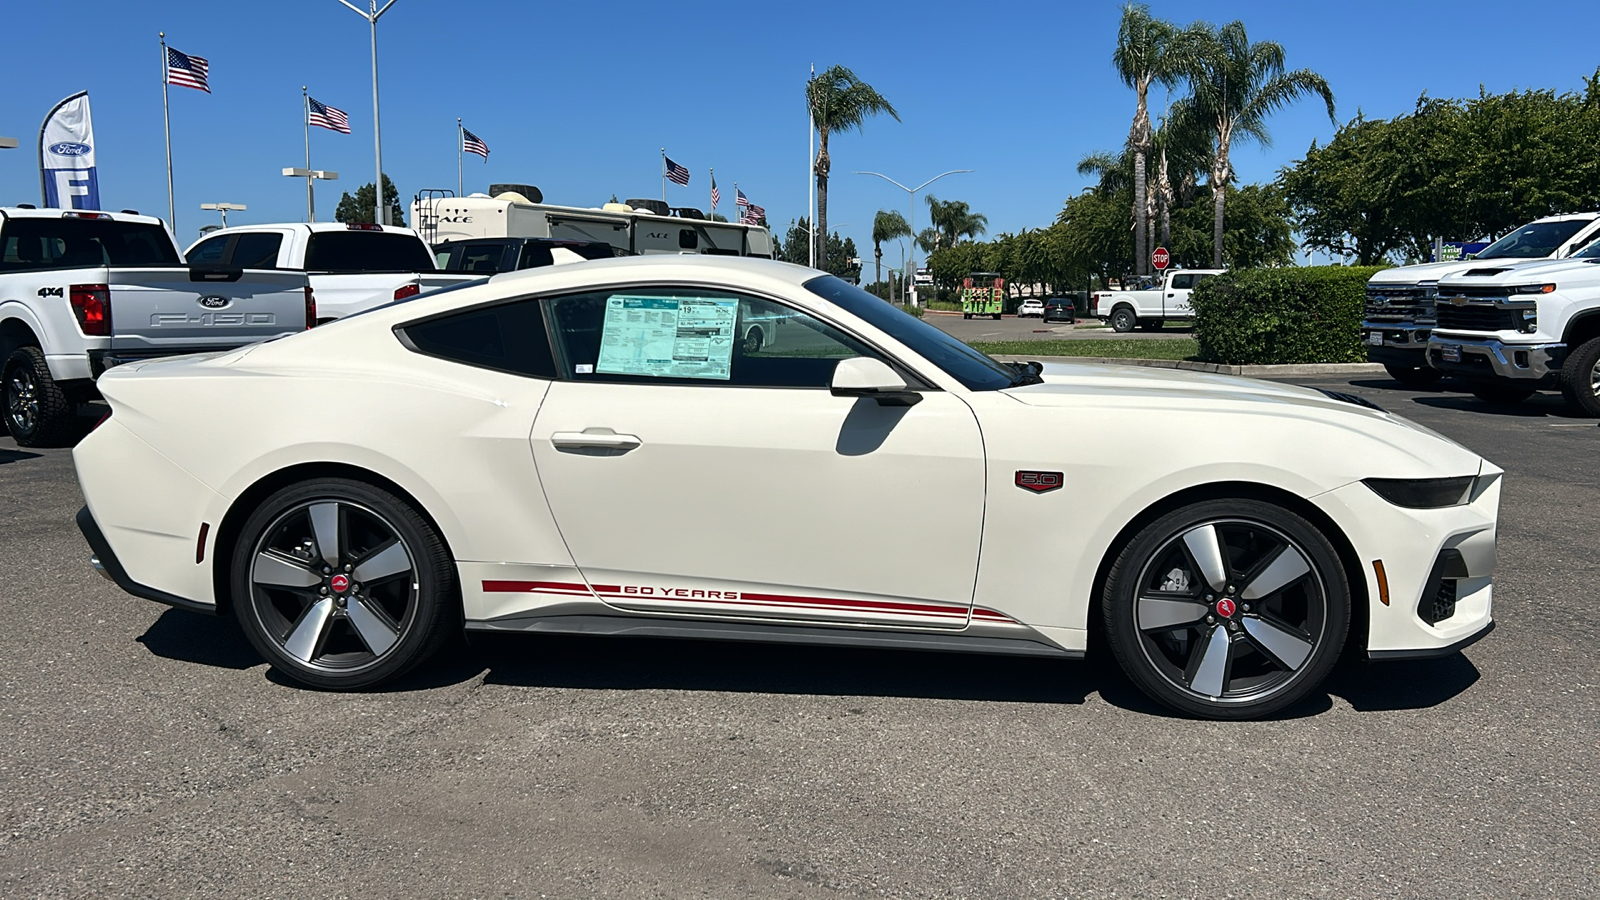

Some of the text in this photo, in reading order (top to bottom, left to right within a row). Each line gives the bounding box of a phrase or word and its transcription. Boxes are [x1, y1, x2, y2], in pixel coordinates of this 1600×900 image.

[57, 144, 83, 155] Ford
[55, 171, 89, 210] F
[1153, 254, 1168, 263] STOP
[205, 297, 224, 306] Ford
[150, 312, 276, 327] F-150
[1021, 473, 1058, 485] 5.0
[624, 585, 738, 599] 60 YEARS
